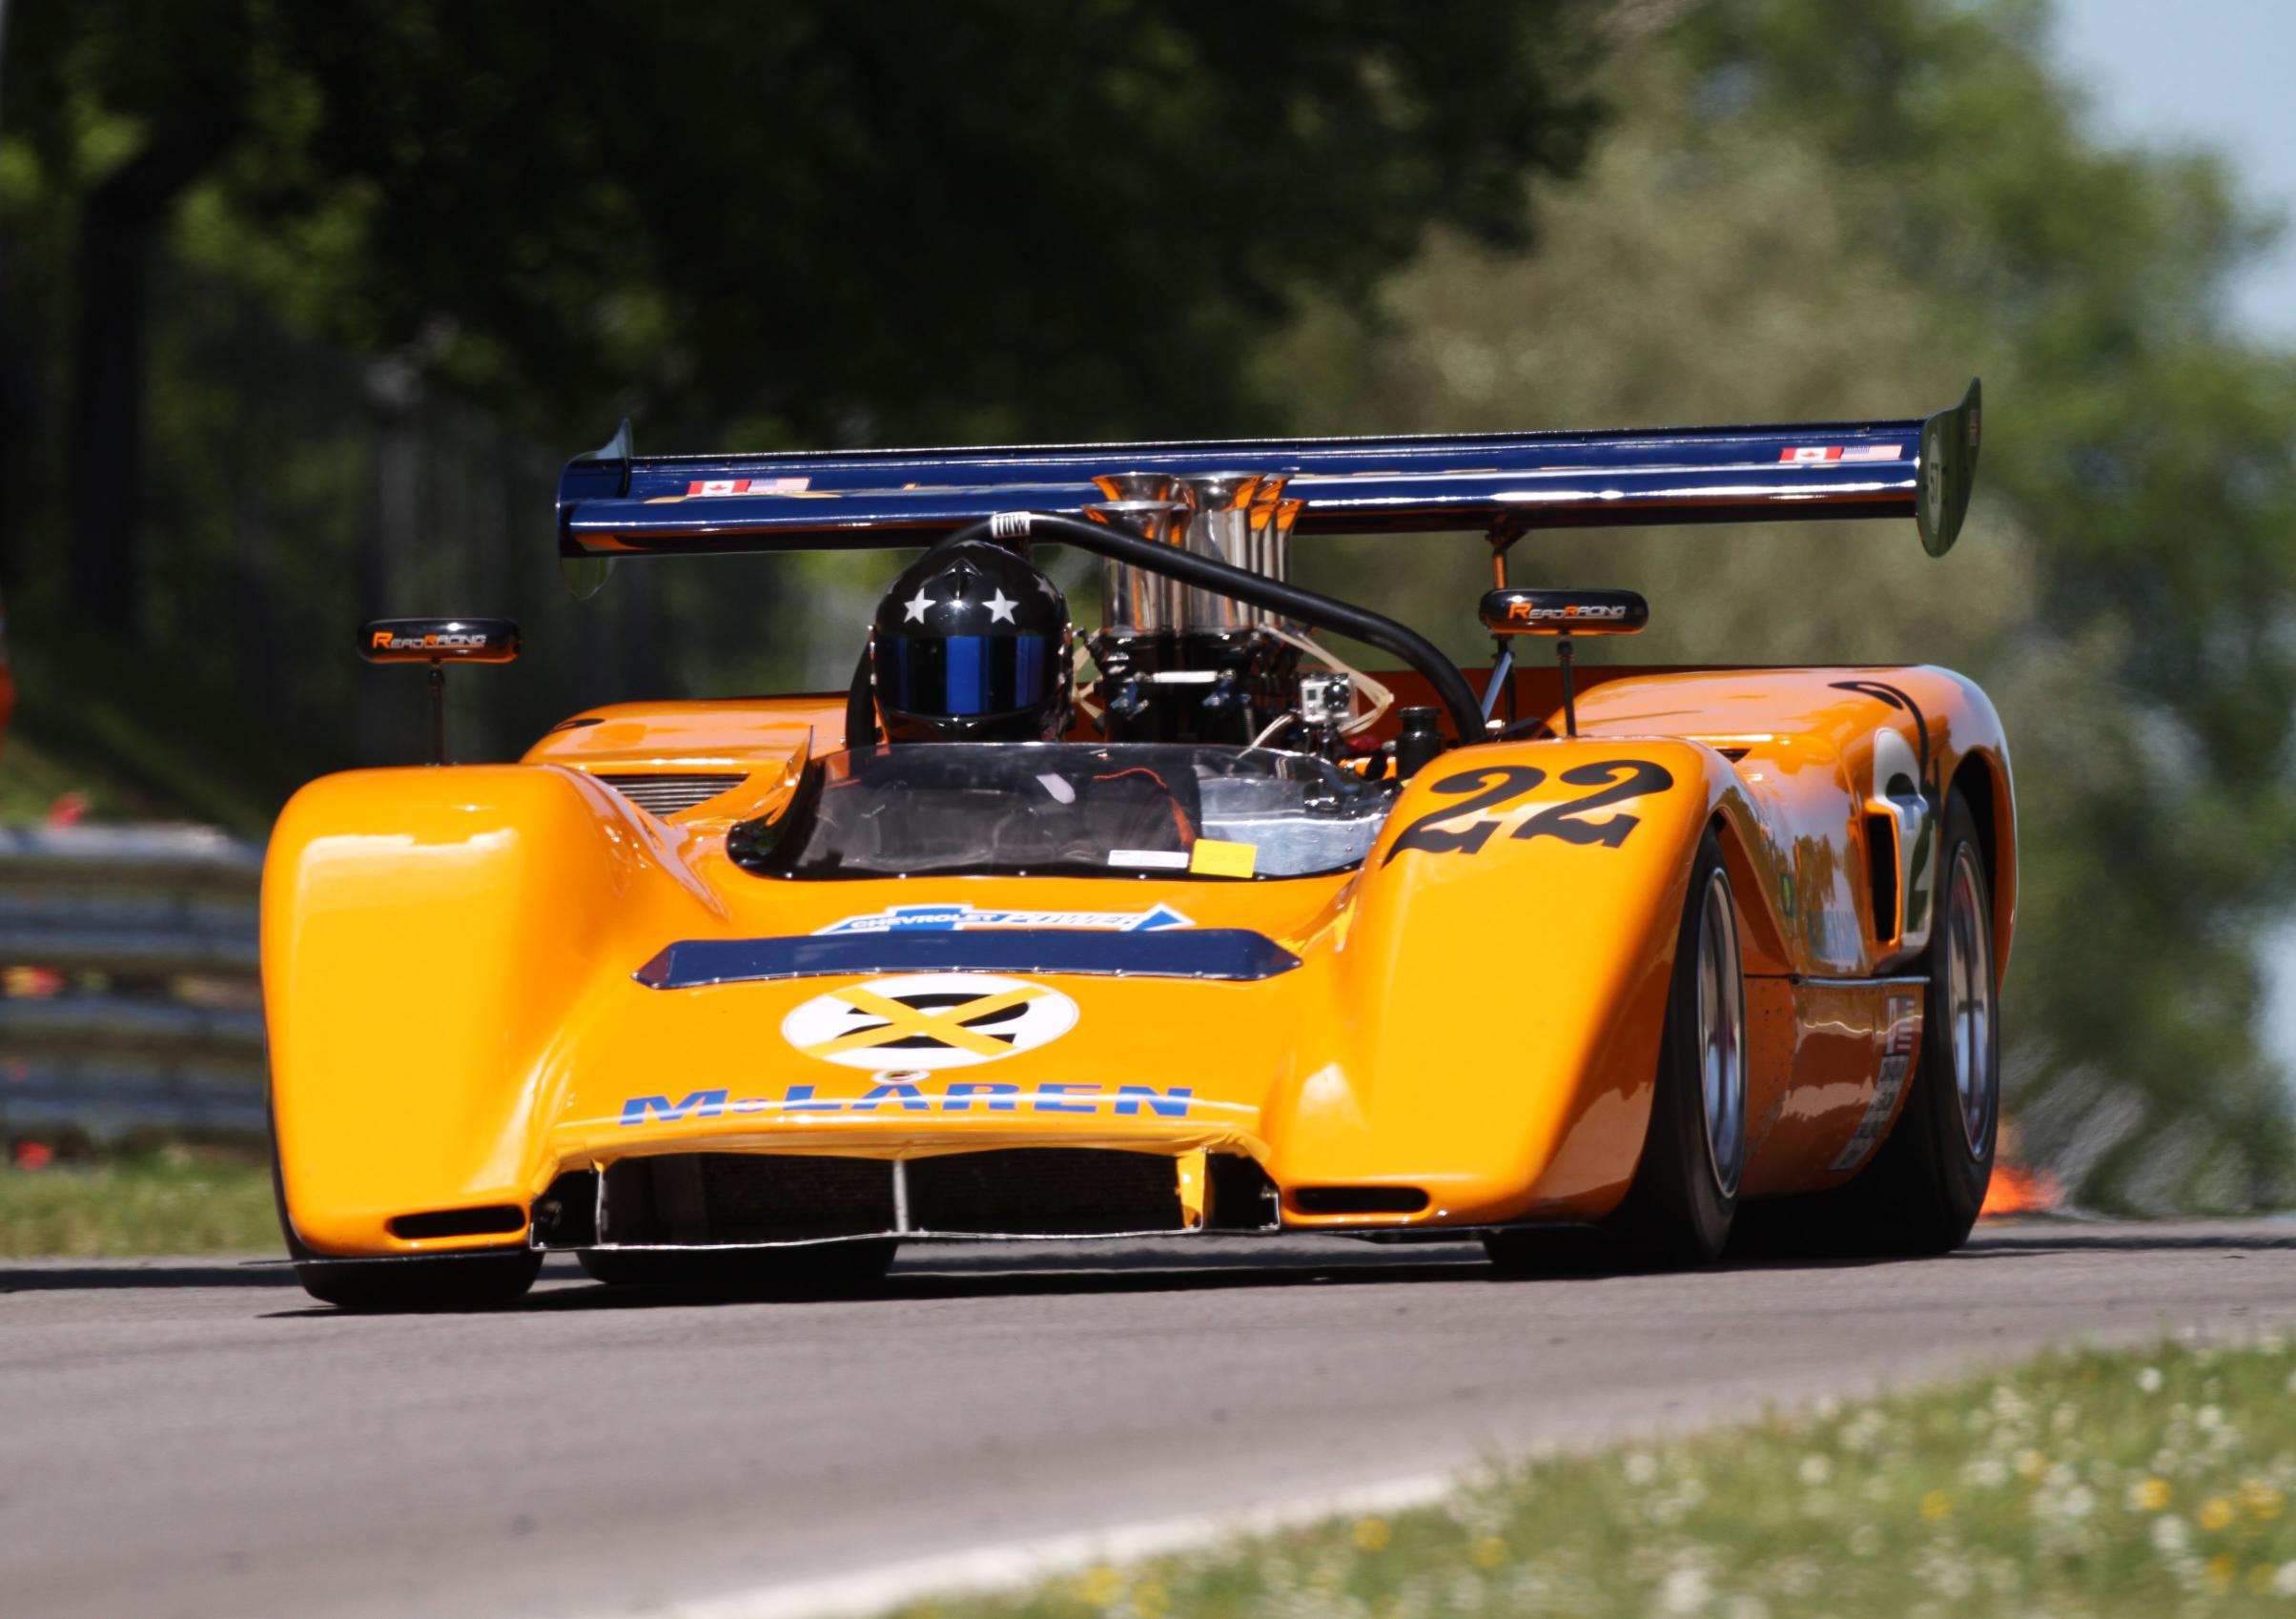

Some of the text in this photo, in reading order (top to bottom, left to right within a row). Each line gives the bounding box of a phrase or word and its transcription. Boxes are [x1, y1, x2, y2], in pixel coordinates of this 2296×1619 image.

[1379, 759, 1674, 871] 22
[850, 912, 1142, 930] CHEVROLET POWER
[619, 1083, 1193, 1126] McLAREN
